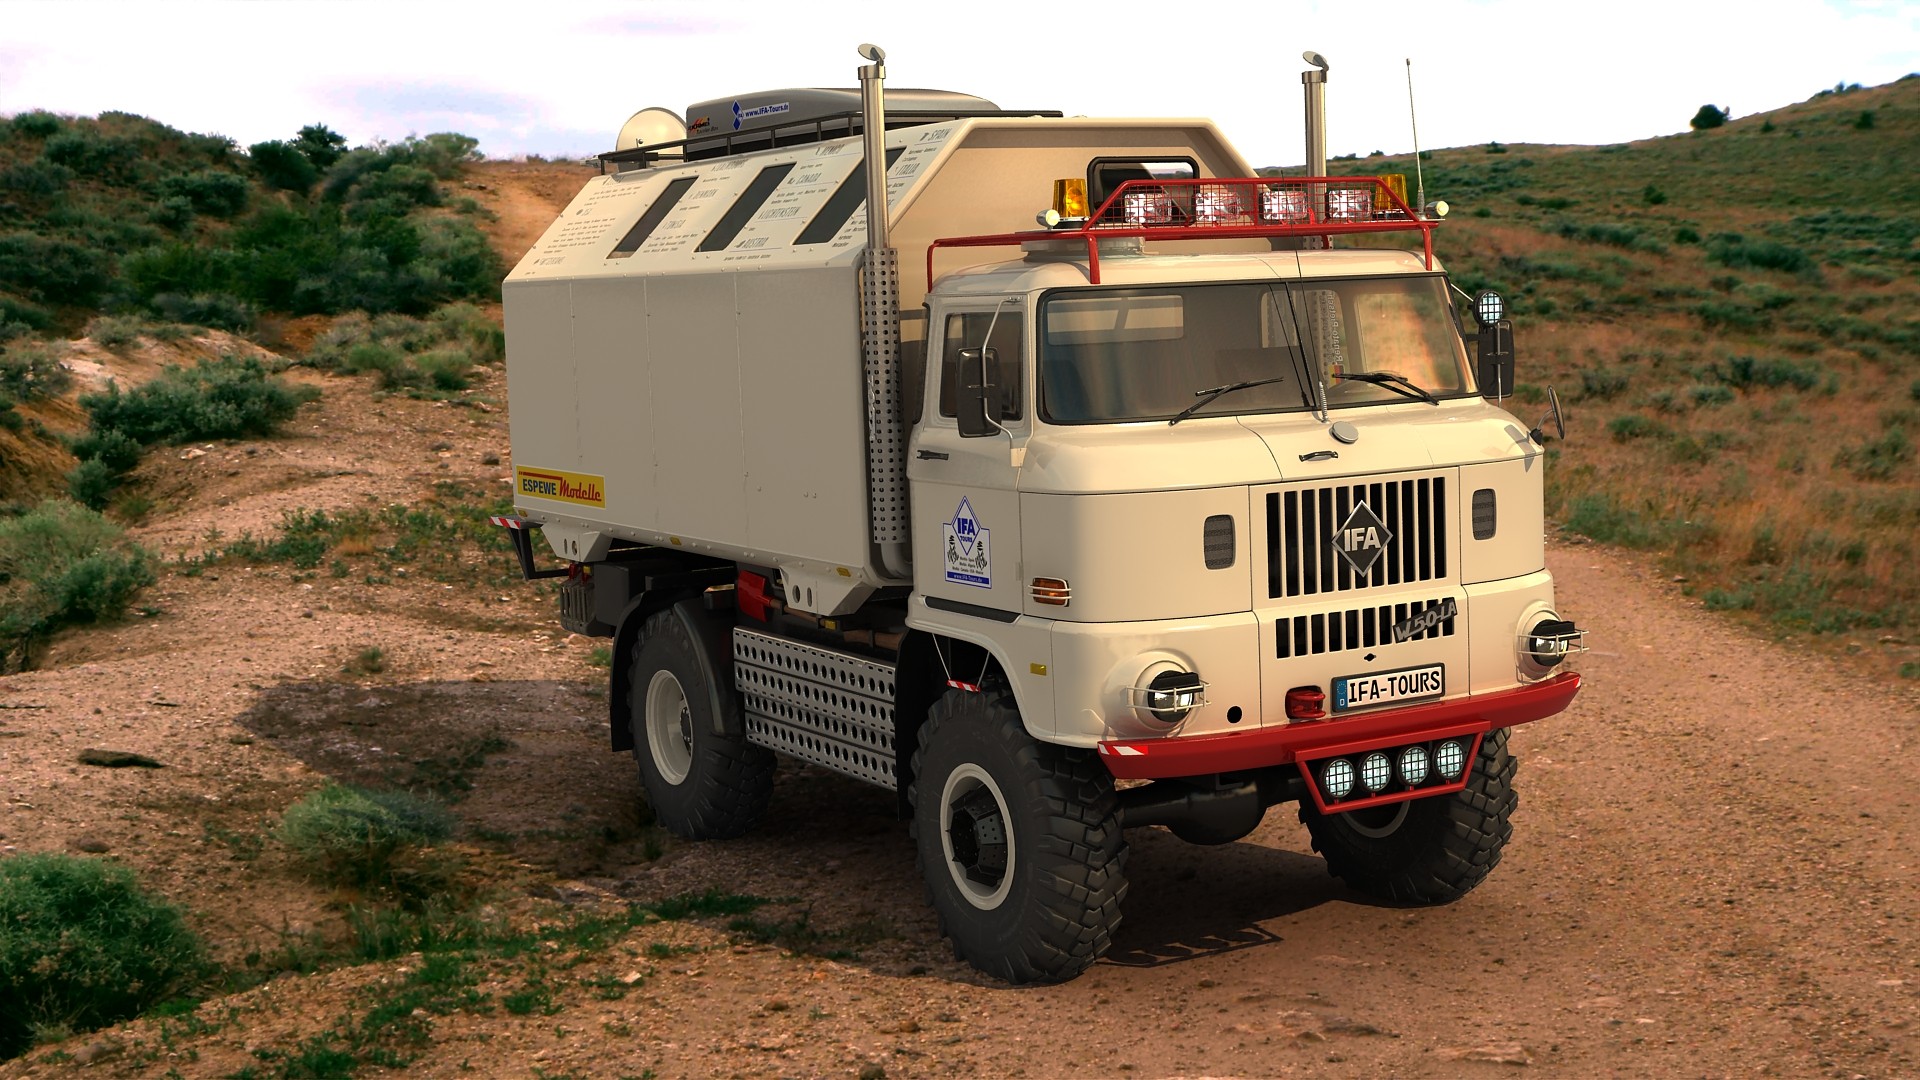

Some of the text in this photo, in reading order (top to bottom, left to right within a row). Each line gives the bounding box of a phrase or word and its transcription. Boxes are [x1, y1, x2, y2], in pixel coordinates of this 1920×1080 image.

[522, 478, 601, 501] ESPEWE Modelle
[957, 517, 975, 535] IFA
[1343, 526, 1381, 552] IFA
[1348, 671, 1440, 702] IFA-TOURS
